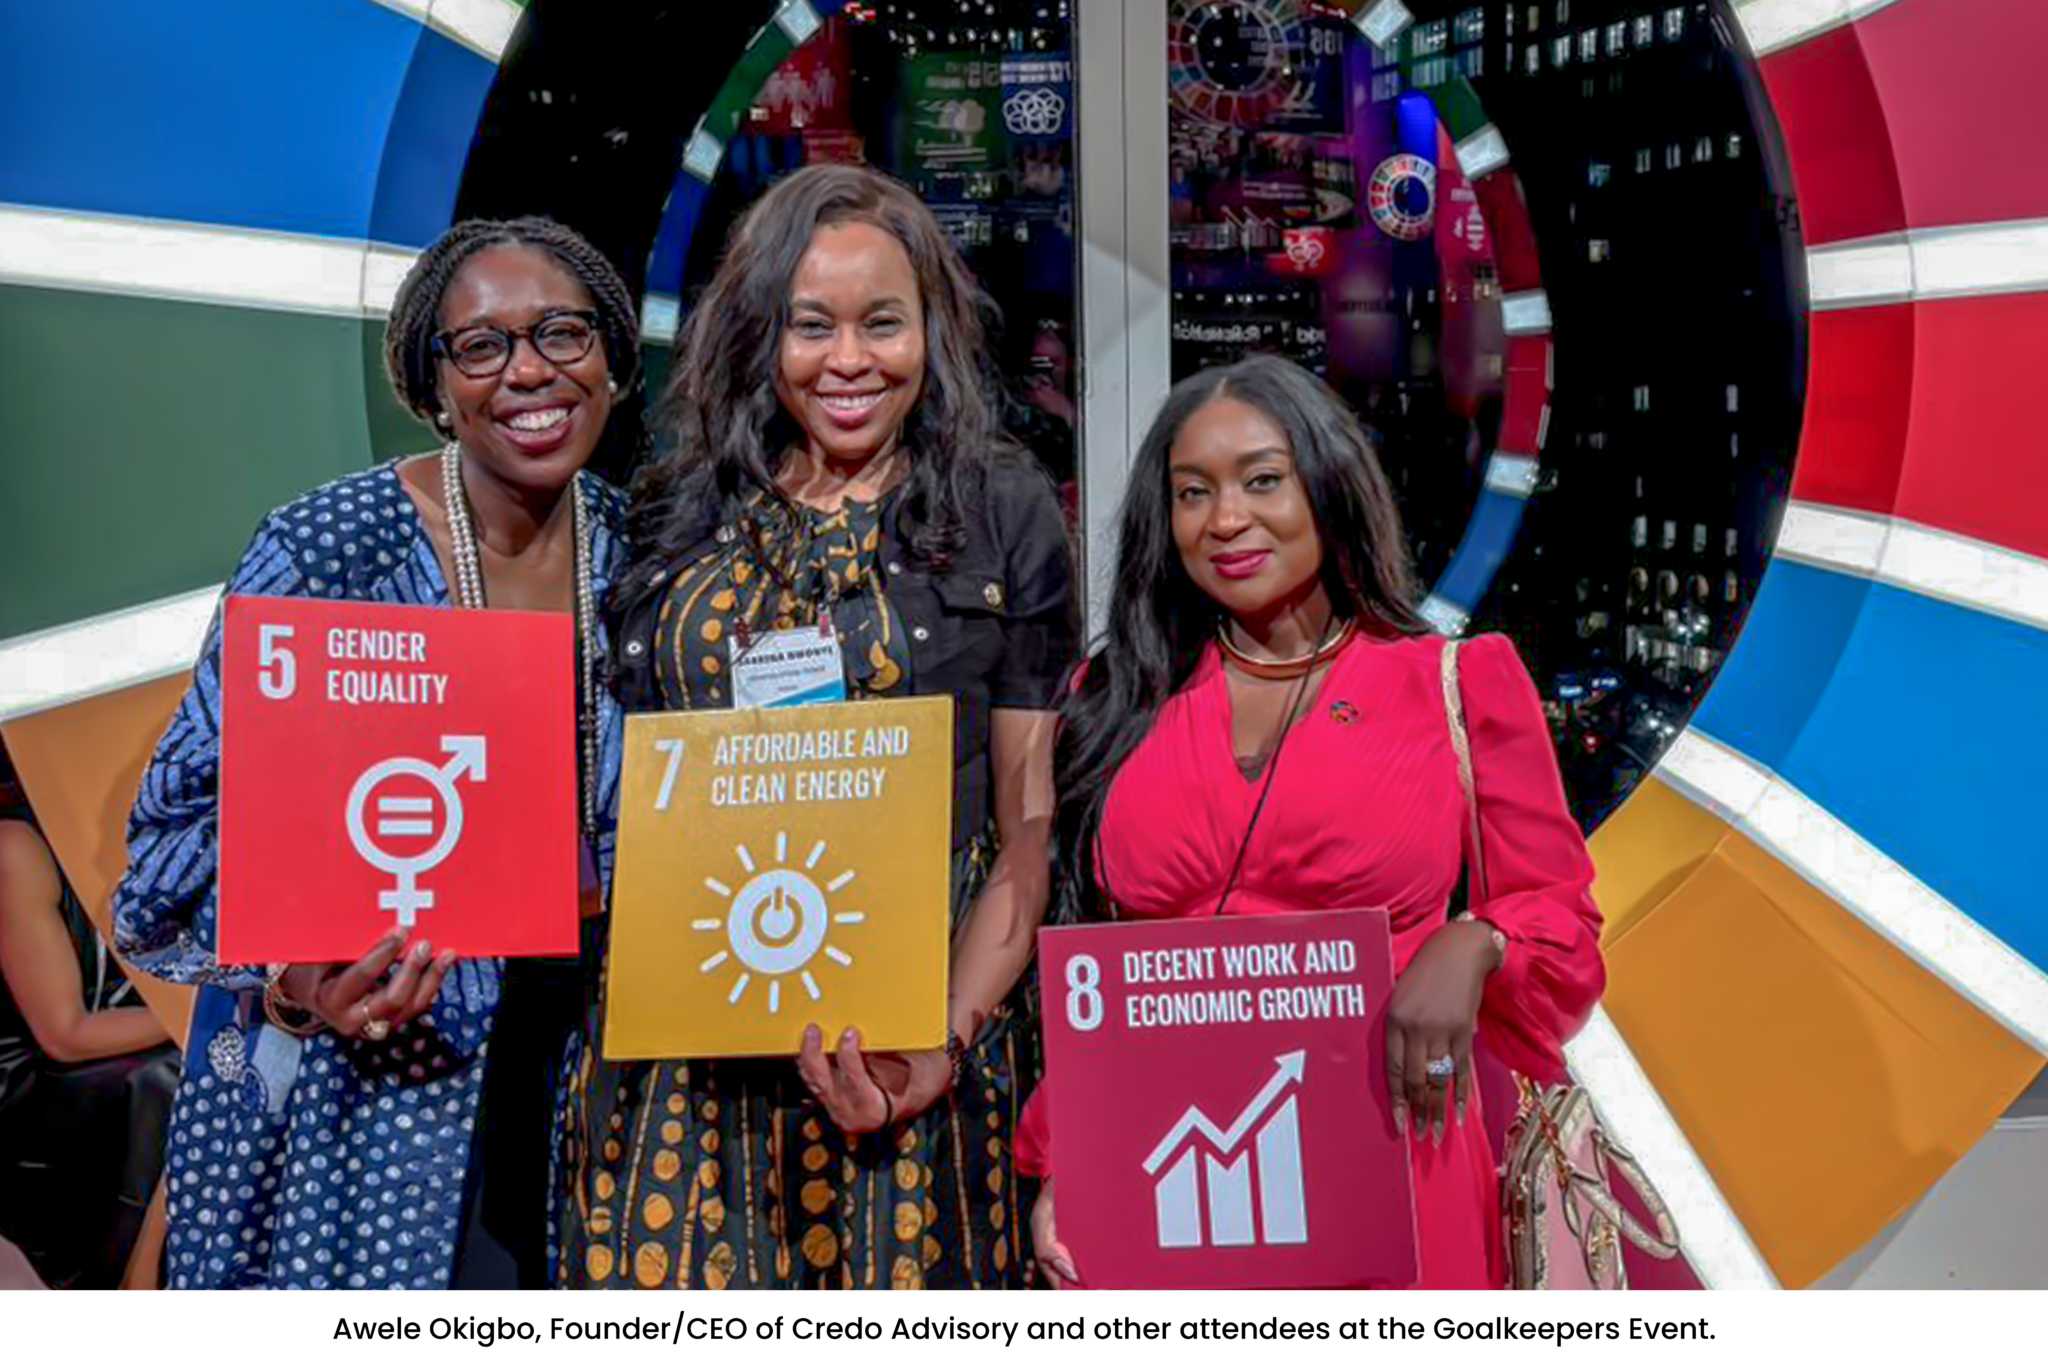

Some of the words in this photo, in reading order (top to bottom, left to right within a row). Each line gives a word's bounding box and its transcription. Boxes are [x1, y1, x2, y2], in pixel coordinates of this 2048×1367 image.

[257, 622, 297, 701] 5
[327, 627, 427, 664] GENDER
[326, 669, 449, 706] EQUALITY
[713, 727, 858, 769] AFFORDABLE
[861, 726, 911, 760] AND
[653, 738, 686, 812] 7
[710, 772, 788, 807] CLEAN
[795, 768, 887, 803] ENERGY
[1123, 947, 1216, 985] DECENT
[1220, 942, 1299, 979] WORK
[1304, 939, 1356, 975] AND
[1065, 954, 1104, 1032] 8
[1126, 989, 1254, 1029] ECONOMIC
[1258, 983, 1366, 1022] GROWTH
